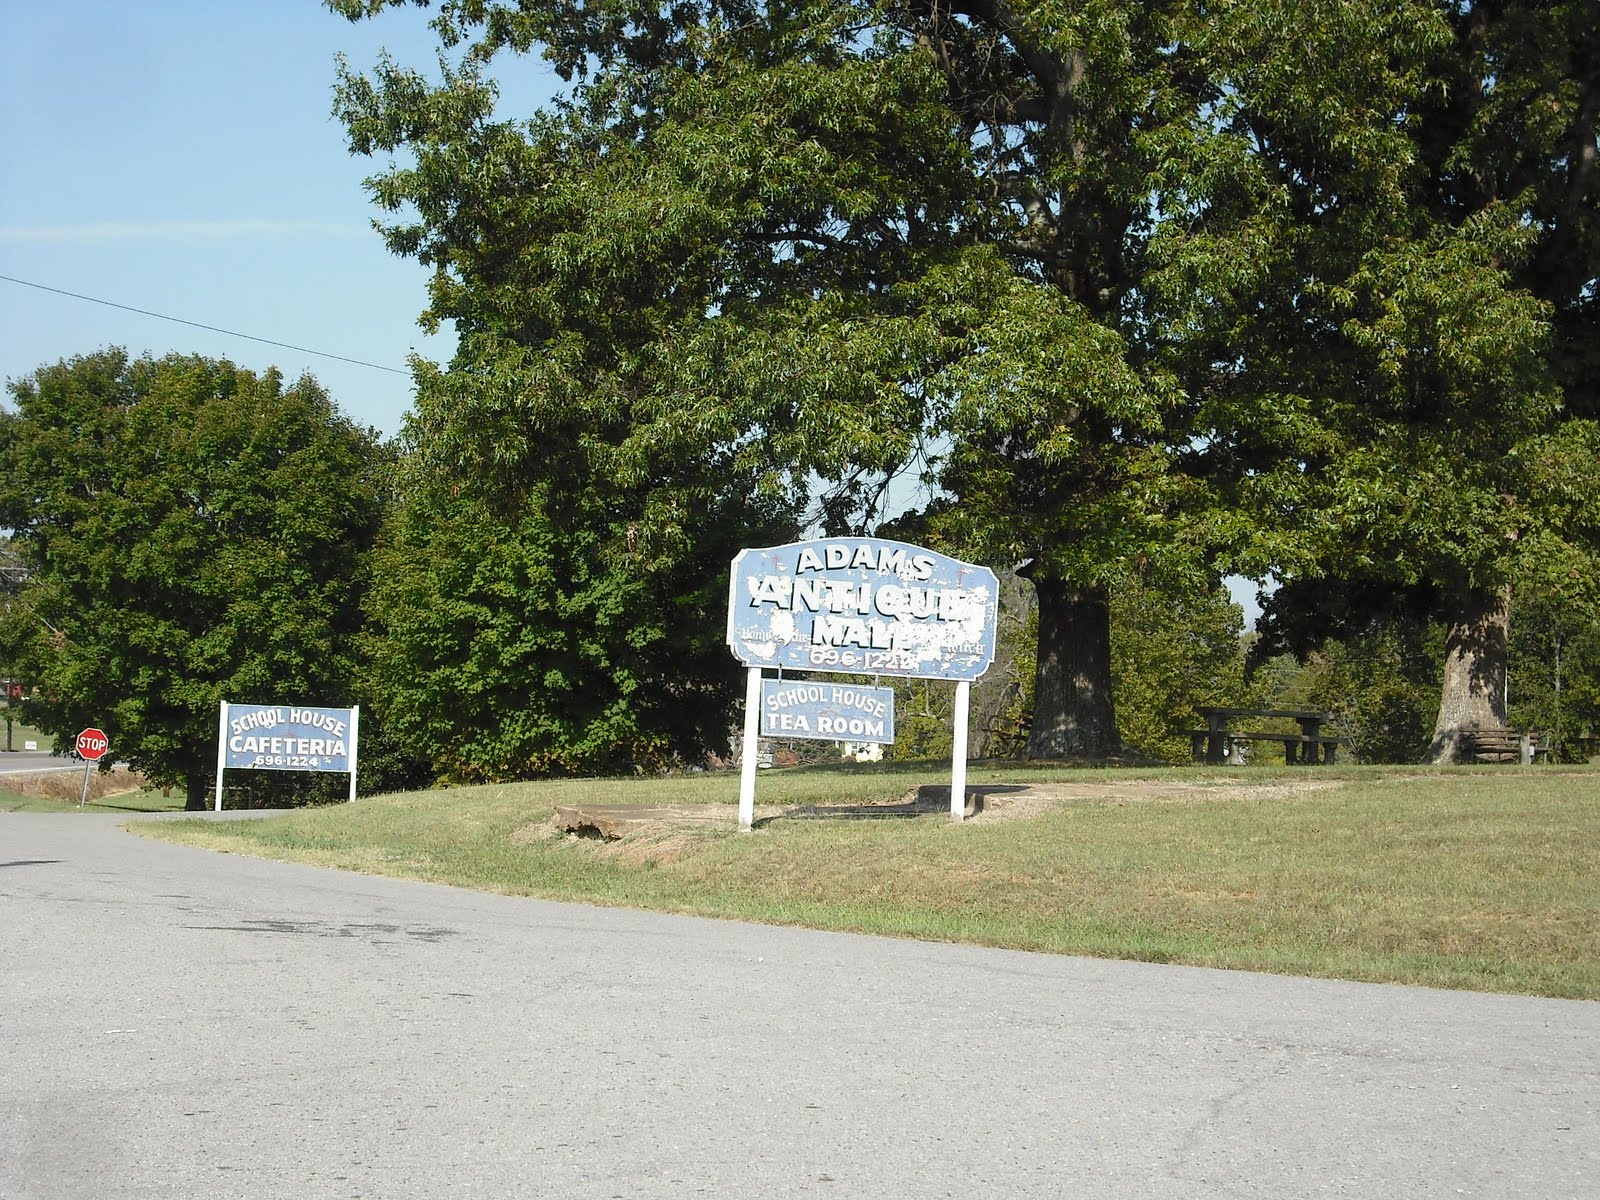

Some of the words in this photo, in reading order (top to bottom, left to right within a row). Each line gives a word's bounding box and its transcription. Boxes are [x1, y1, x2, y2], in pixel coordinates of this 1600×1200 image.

[796, 544, 936, 580] ADAMS
[750, 575, 968, 621] ANTIQUE
[767, 687, 829, 711] SCHOOL
[832, 687, 887, 719] HOUSE
[230, 708, 286, 736] SCHOOL
[290, 708, 347, 738] HOUSE
[767, 713, 811, 732] TEA
[817, 716, 885, 737] ROOM
[78, 736, 107, 752] STOP
[229, 736, 347, 757] CAFETERIA
